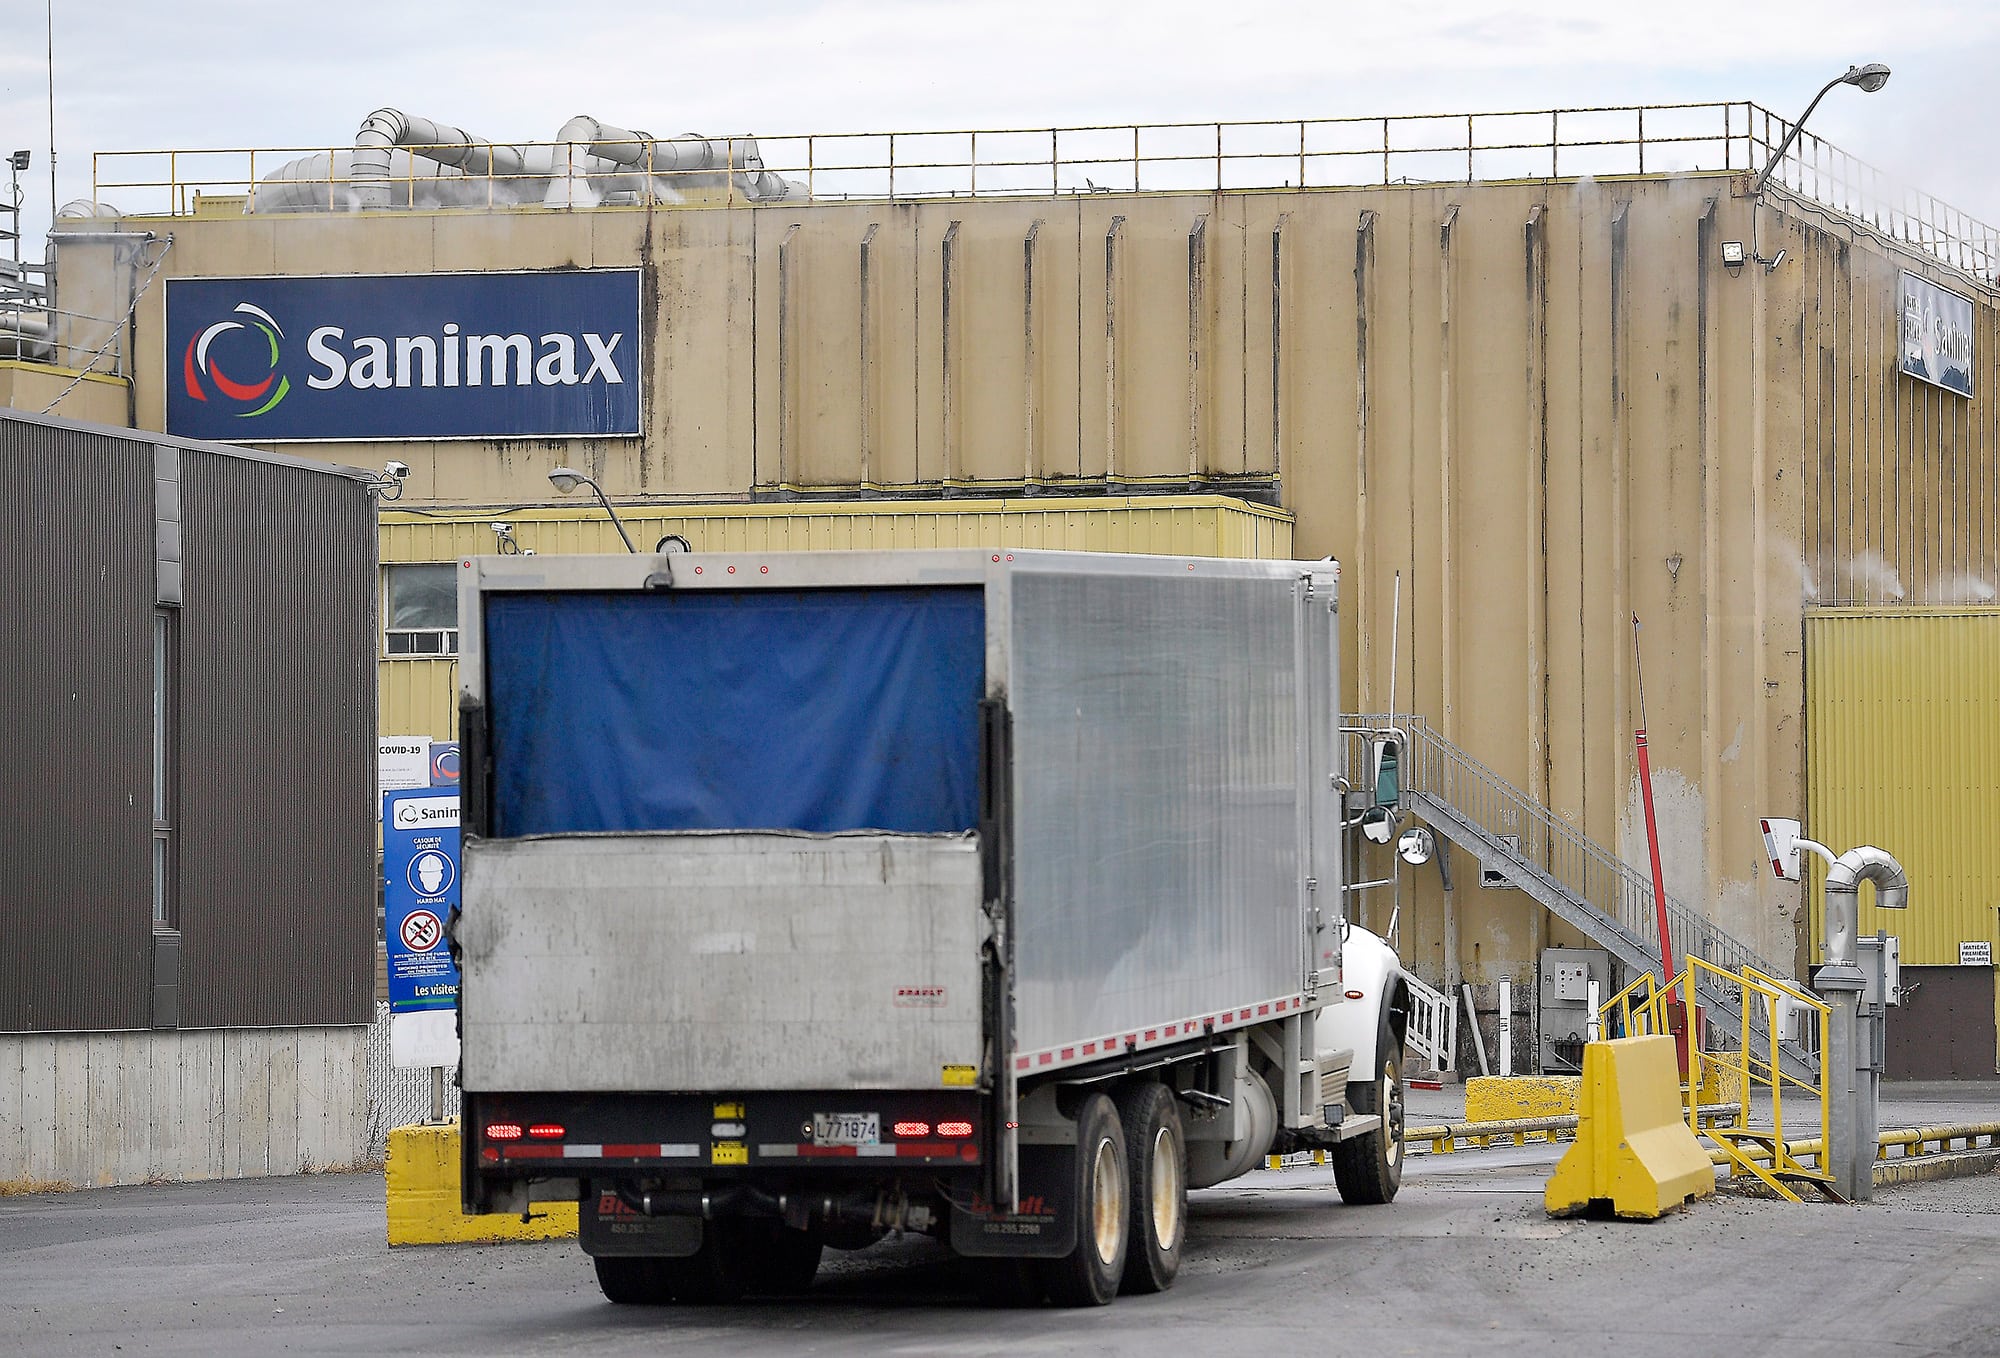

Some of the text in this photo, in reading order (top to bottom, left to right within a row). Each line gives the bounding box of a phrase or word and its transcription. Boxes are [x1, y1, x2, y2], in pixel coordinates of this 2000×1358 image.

[306, 323, 624, 390] Sanimax
[379, 746, 421, 755] COVID-19
[415, 985, 429, 996] Les
[816, 1121, 876, 1139] L771874
